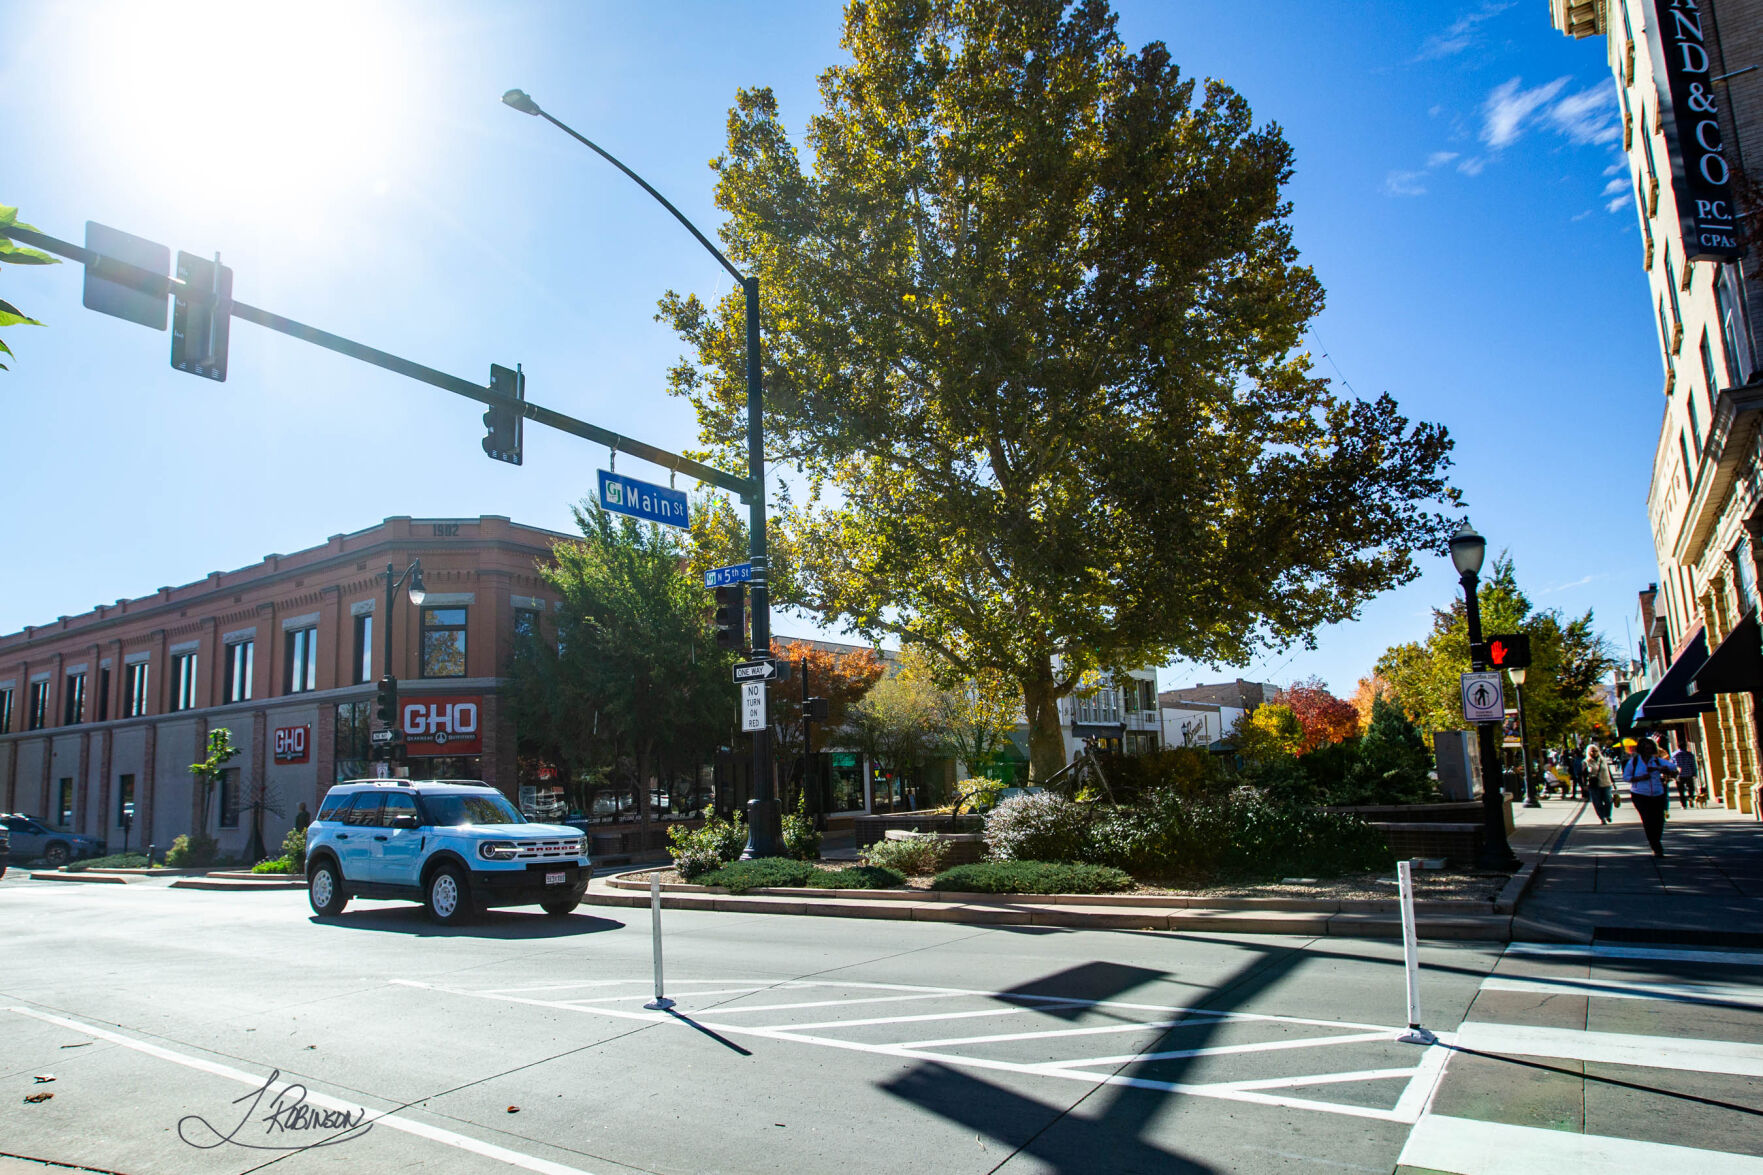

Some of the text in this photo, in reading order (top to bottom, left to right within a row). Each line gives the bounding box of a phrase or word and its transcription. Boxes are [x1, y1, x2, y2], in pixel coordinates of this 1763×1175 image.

[1668, 0, 1730, 185] ND & CO
[1695, 200, 1733, 220] P.C.
[626, 485, 671, 517] Main
[673, 502, 684, 516] St
[717, 572, 723, 581] N
[724, 568, 739, 583] 5th
[741, 568, 749, 578] St
[737, 666, 763, 677] ONE WAY
[748, 685, 759, 696] NO
[747, 698, 761, 707] TURN
[404, 703, 477, 734] GHO
[749, 709, 758, 717] ON
[748, 719, 760, 728] RED
[275, 728, 305, 753] GHO
